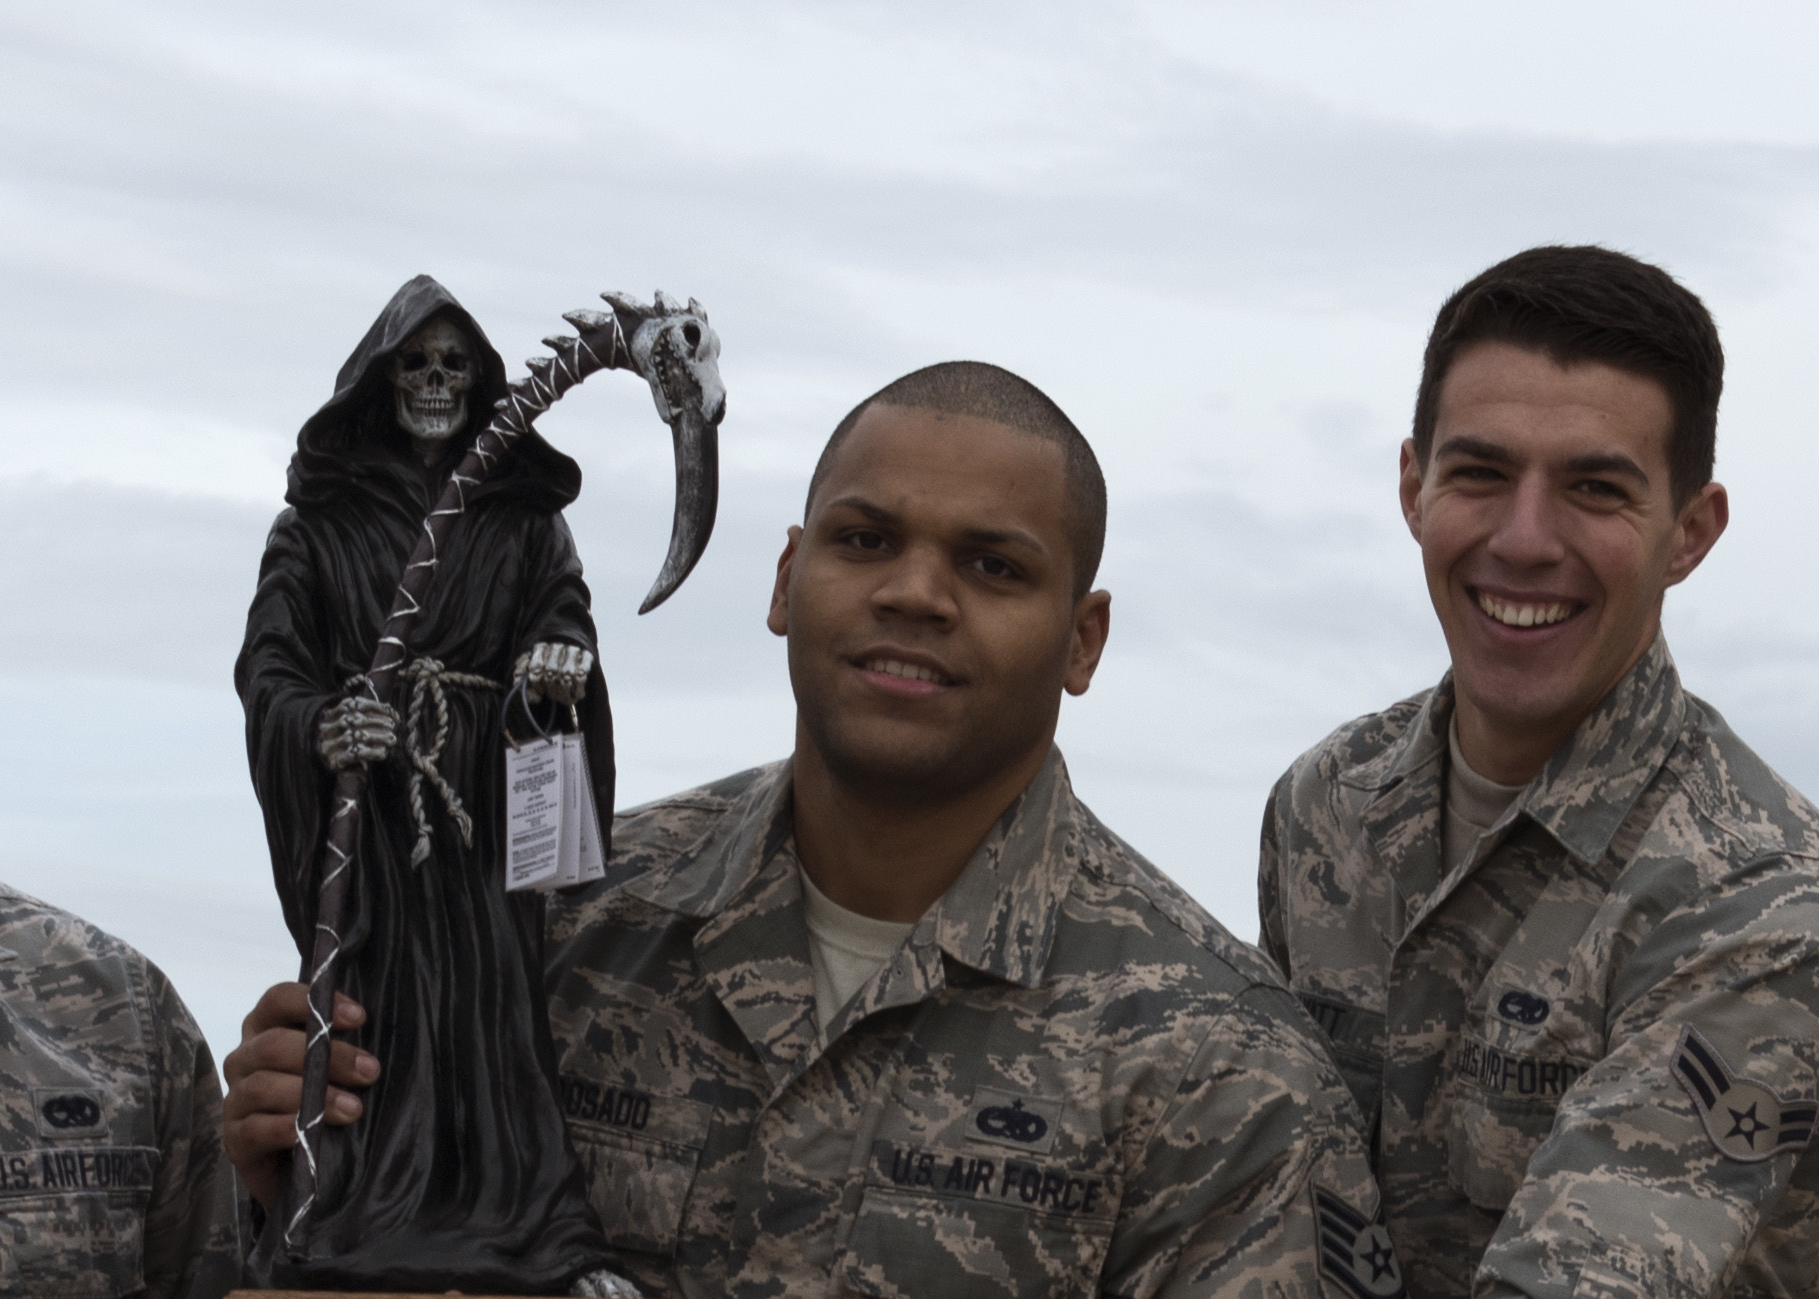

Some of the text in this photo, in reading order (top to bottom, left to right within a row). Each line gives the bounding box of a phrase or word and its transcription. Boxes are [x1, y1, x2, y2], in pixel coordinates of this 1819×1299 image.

[1502, 1055, 1589, 1095] FORC
[42, 1150, 78, 1188] AIR
[891, 1149, 1103, 1213] U.S. AIR FORCE
